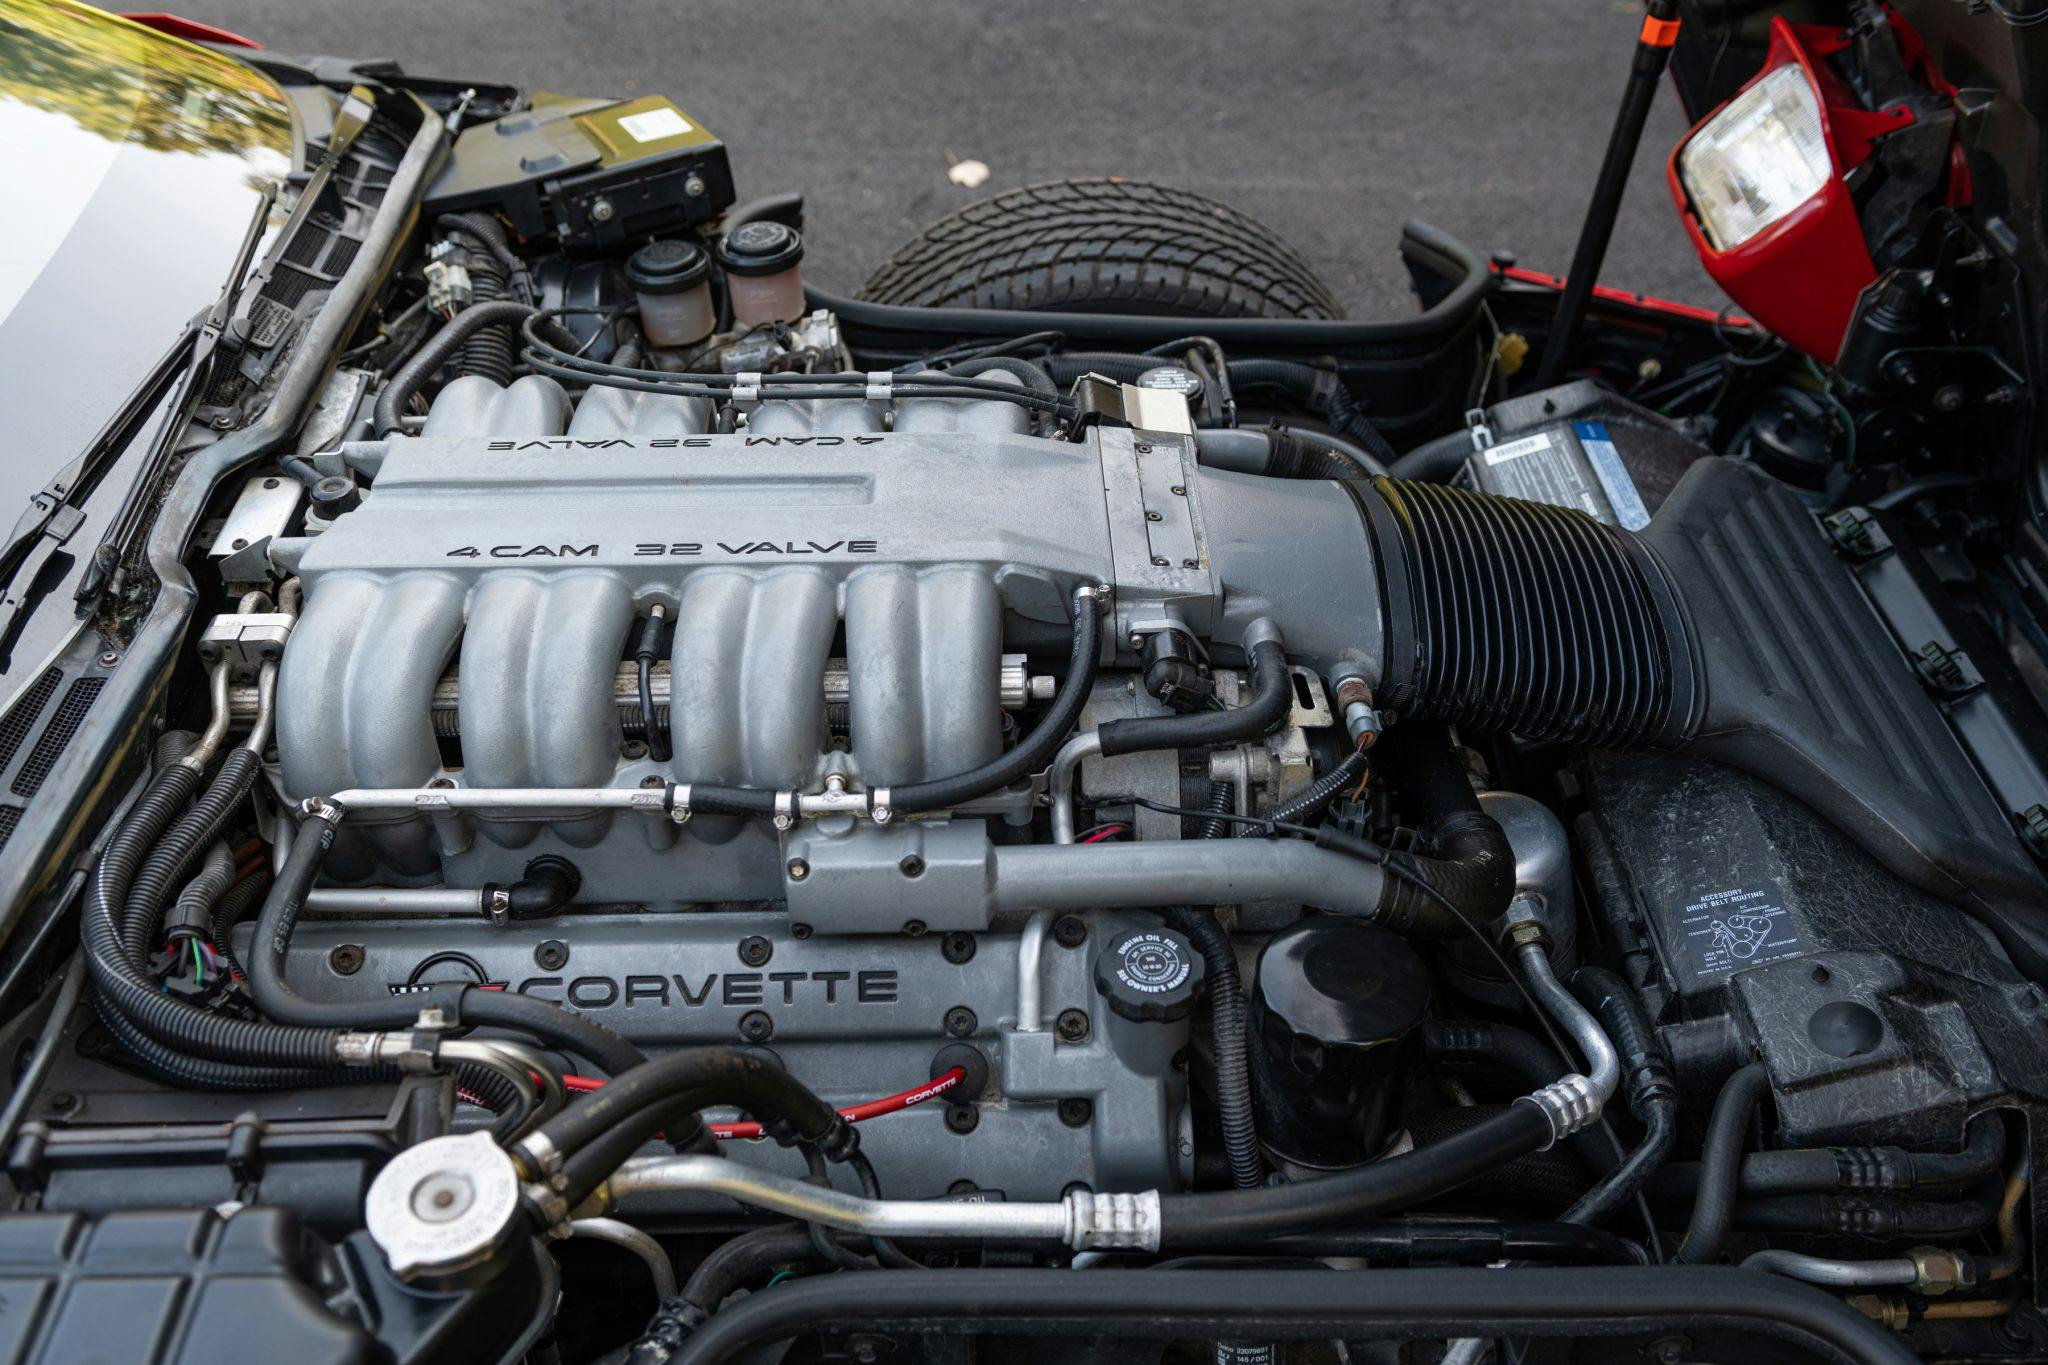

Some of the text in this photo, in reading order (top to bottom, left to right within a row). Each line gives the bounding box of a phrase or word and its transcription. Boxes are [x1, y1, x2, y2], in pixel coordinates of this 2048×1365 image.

[486, 436, 885, 451] 4 CAM 32 VALVE
[446, 540, 878, 558] 4 CAM 32 VALVE
[1686, 890, 1765, 912] DRIVE BELT ROUTING
[1700, 888, 1743, 903] ACCESSORY
[1682, 915, 1710, 924] ALTERNATOR
[1118, 934, 1179, 955] ENGINE OIL FILL
[1140, 945, 1163, 953] SERVICE
[1116, 963, 1190, 993] SEE OWNER'S MANUAL
[518, 970, 898, 1010] CORVETTE
[905, 1077, 957, 1105] CORVETTE
